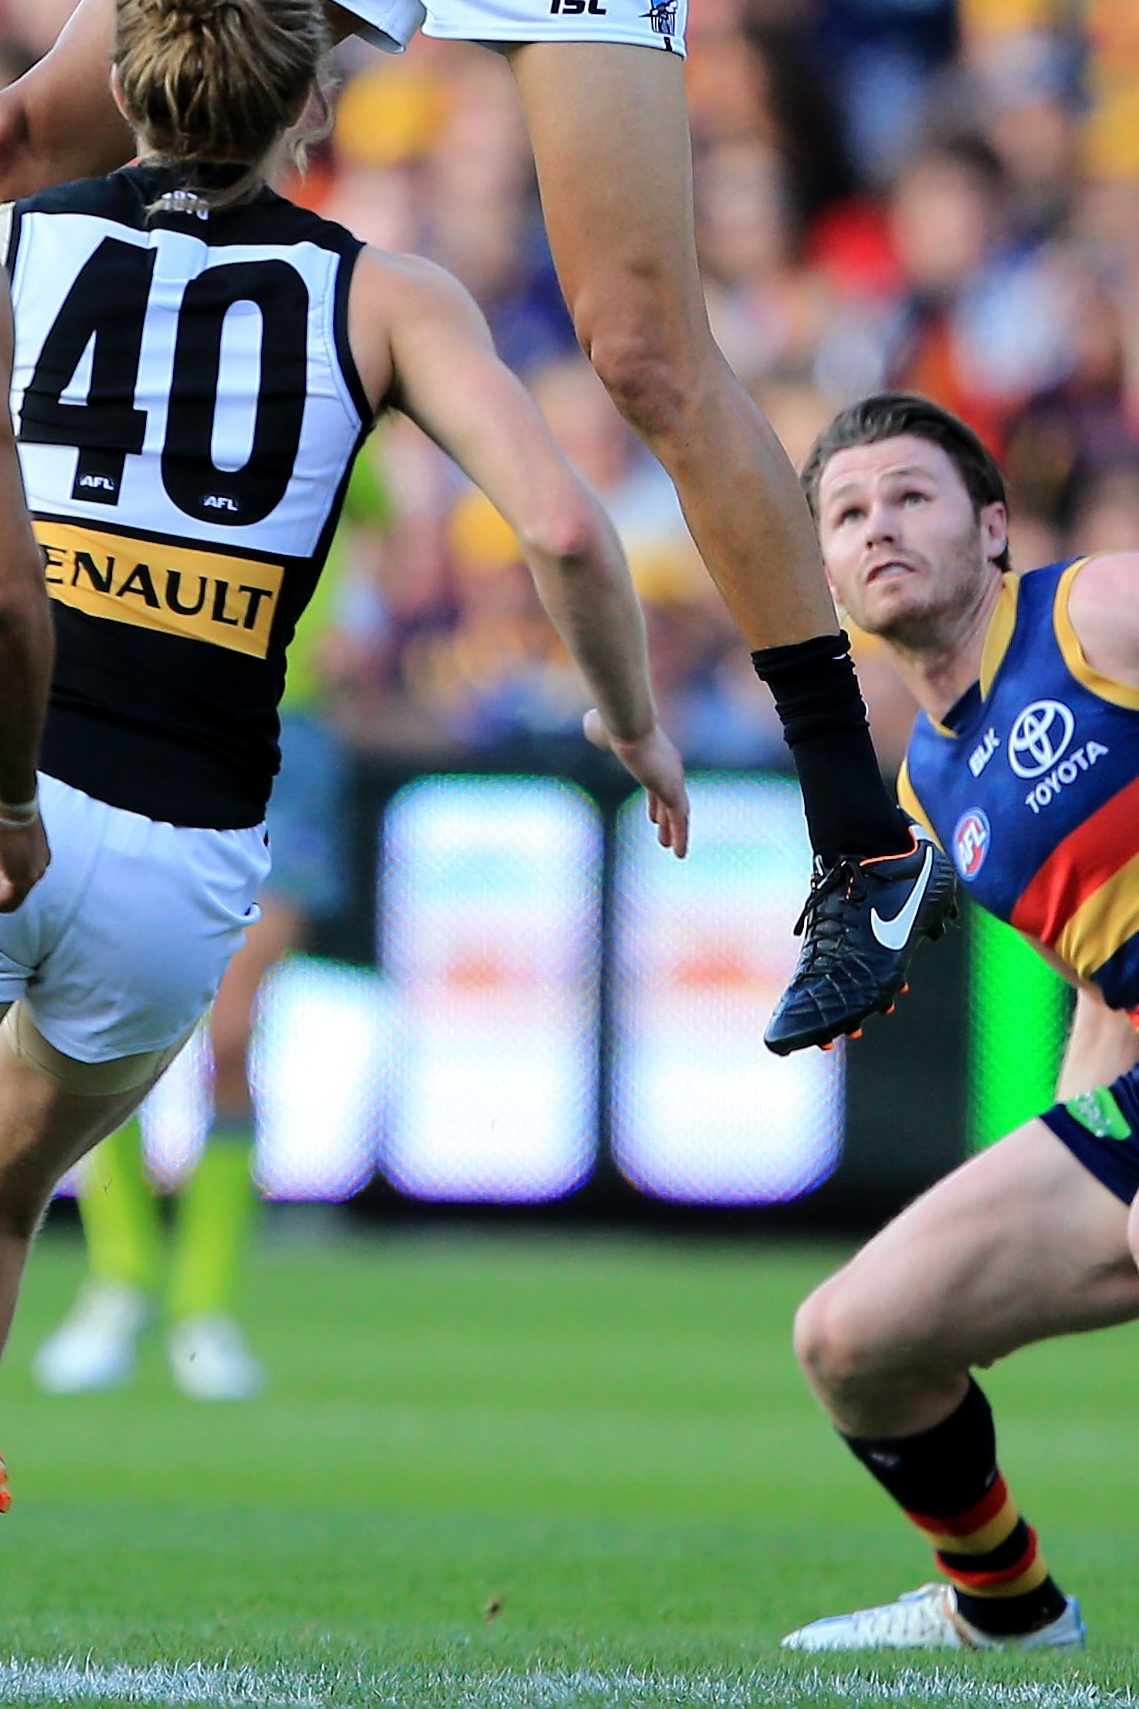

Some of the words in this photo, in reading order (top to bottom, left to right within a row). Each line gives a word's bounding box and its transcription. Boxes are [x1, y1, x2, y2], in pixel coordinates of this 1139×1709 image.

[18, 236, 309, 527] 40
[79, 474, 116, 491] AFL
[203, 494, 239, 511] AFL
[40, 544, 273, 630] ENAULT
[969, 727, 1000, 777] BLK
[1025, 740, 1109, 814] TOYOTA
[958, 821, 987, 873] AFL
